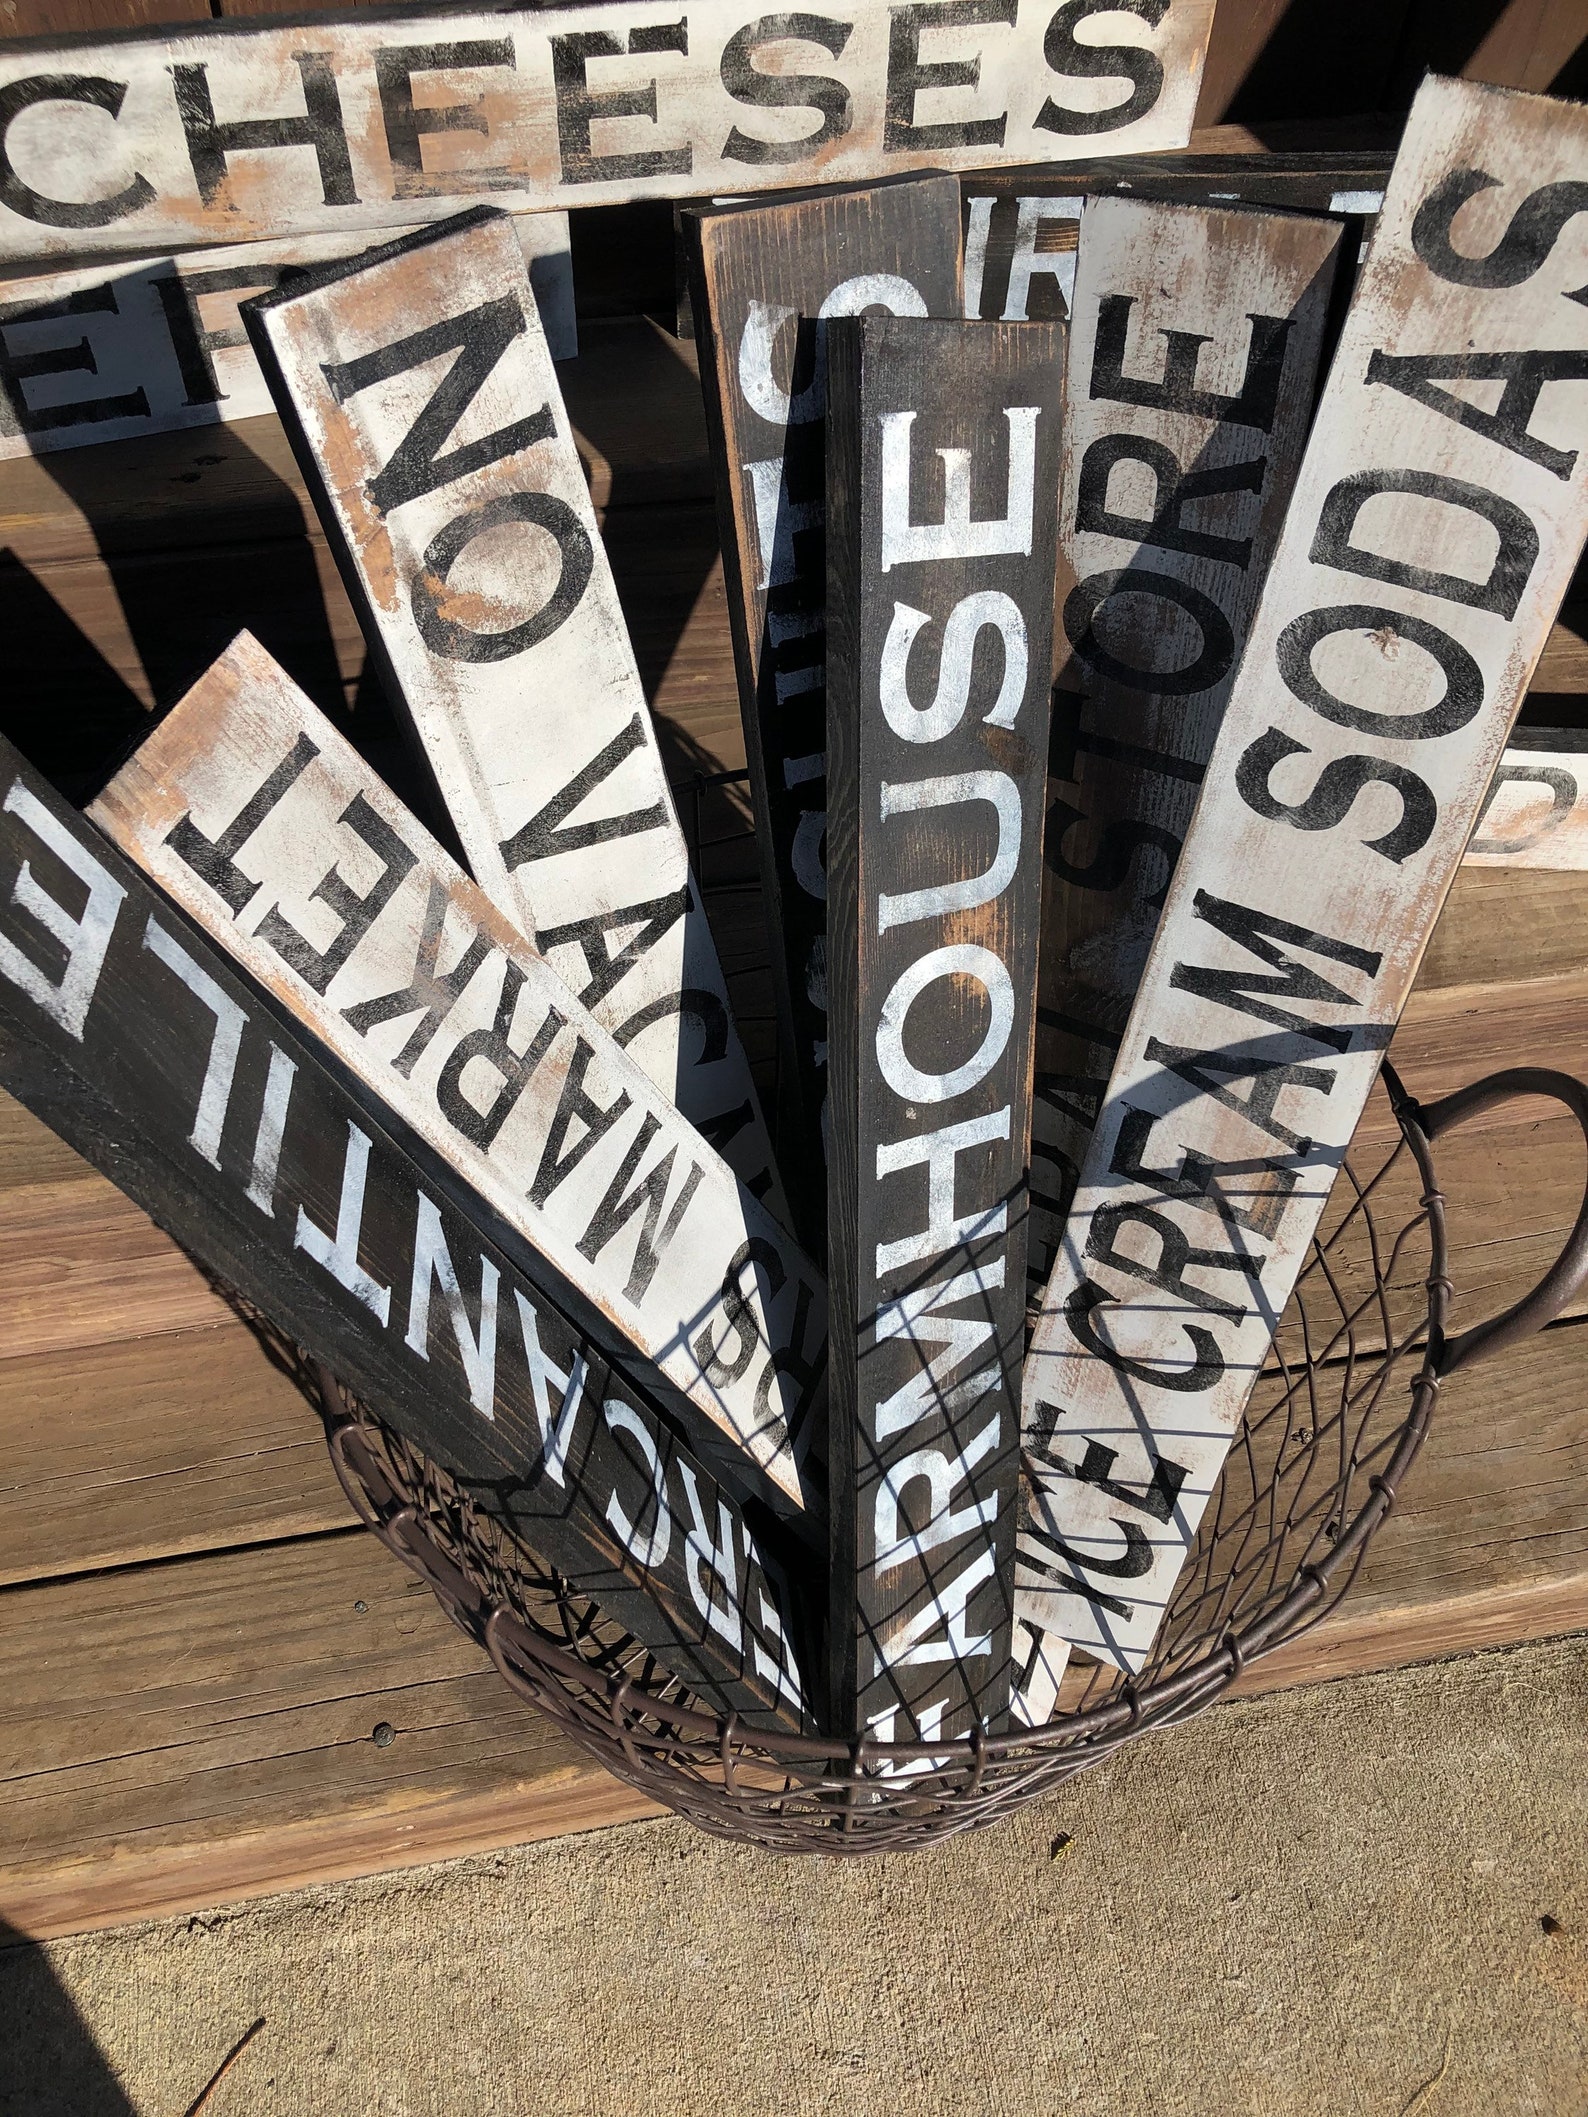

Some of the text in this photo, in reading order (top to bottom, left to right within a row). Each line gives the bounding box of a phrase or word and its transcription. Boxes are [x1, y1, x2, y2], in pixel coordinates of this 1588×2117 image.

[0, 0, 1167, 228] CHEESES
[319, 288, 594, 663] NO
[1046, 294, 1297, 909] STORE
[1235, 168, 1588, 866] SODAS
[0, 775, 805, 1712] ERCANTILE
[161, 731, 706, 1309] MARKET
[865, 407, 1043, 1792] FARMHOUSE
[1062, 886, 1385, 1393] CREAM
[1015, 1398, 1197, 1622] ICE
